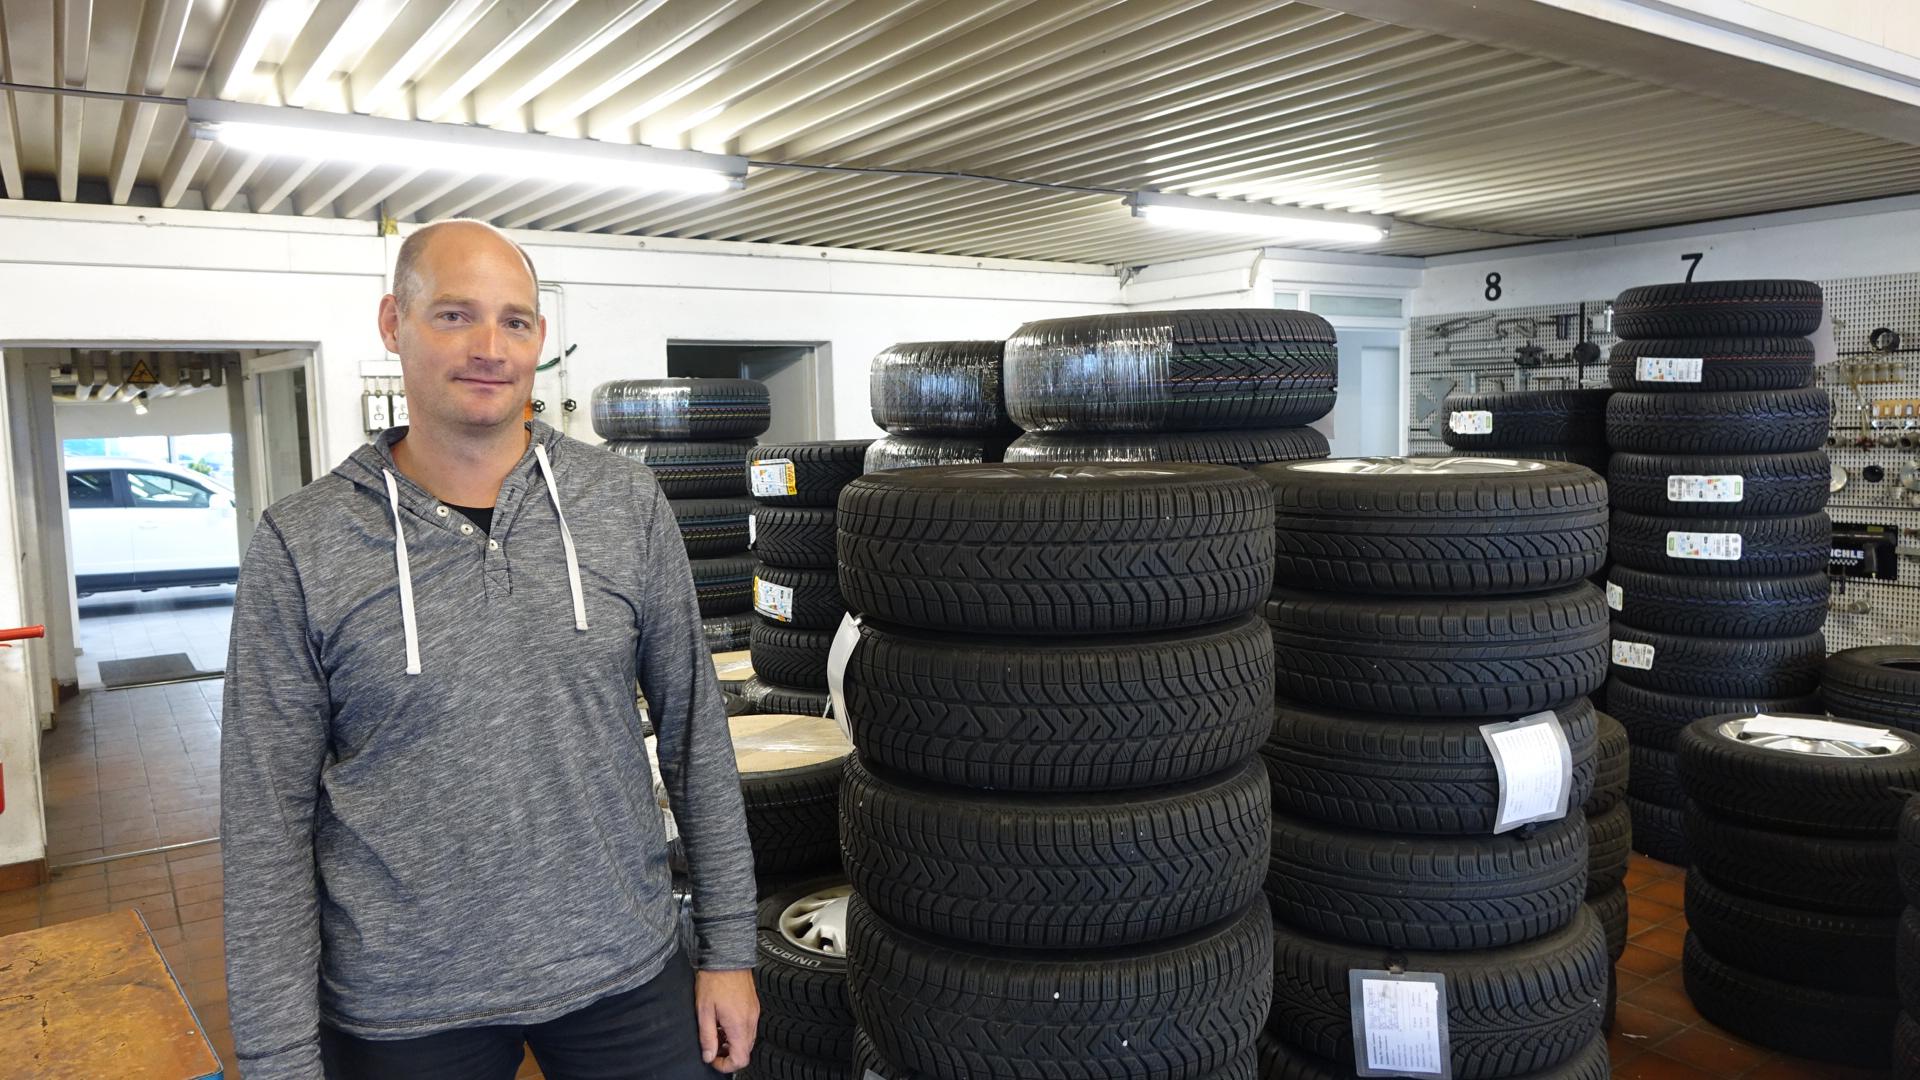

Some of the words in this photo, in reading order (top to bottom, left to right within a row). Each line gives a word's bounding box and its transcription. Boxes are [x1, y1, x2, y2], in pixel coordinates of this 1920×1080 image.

[1681, 253, 1703, 283] 7
[1485, 272, 1502, 301] 8
[1830, 548, 1864, 560] ICHLE
